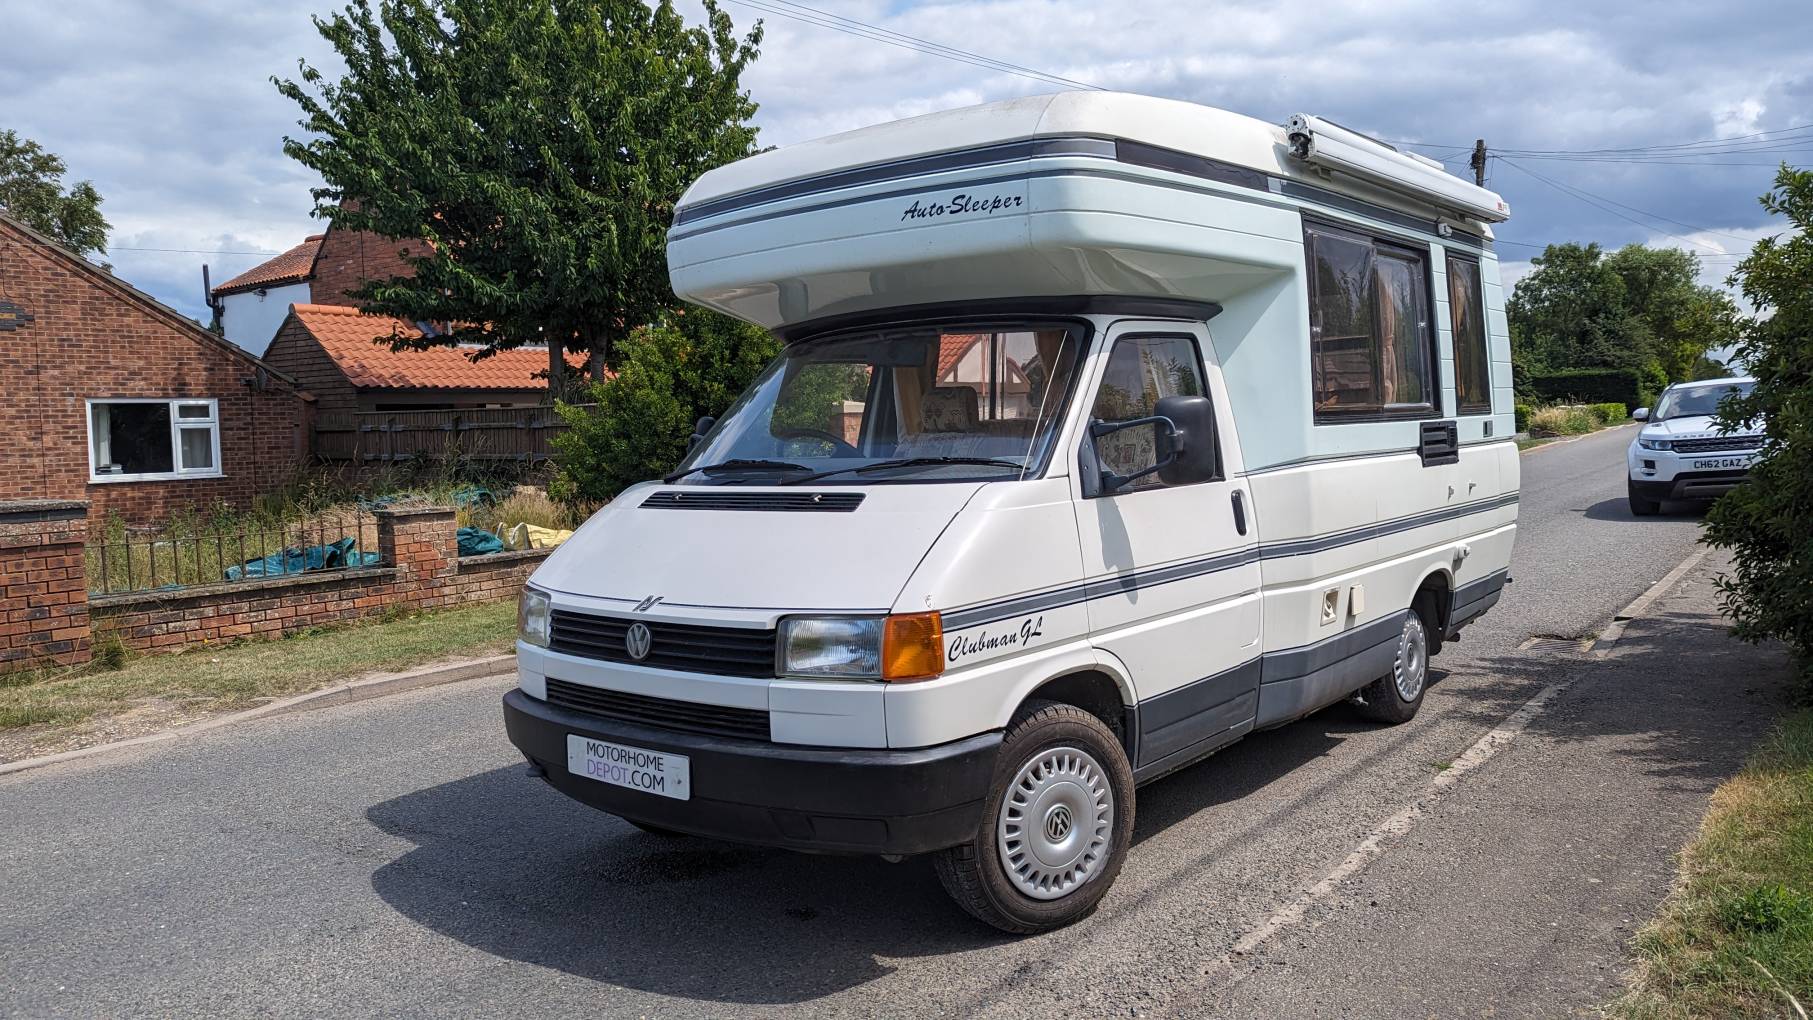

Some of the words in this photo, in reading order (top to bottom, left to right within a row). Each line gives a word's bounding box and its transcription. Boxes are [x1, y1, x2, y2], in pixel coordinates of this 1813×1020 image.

[901, 194, 1023, 222] Auto-Sleeper
[1693, 460, 1720, 469] CH62
[1721, 458, 1742, 468] GAZ
[948, 631, 1018, 662] Clubman
[1020, 615, 1043, 646] GL
[586, 741, 664, 772] MOTORHOME
[587, 759, 665, 792] DEPOT.COM
